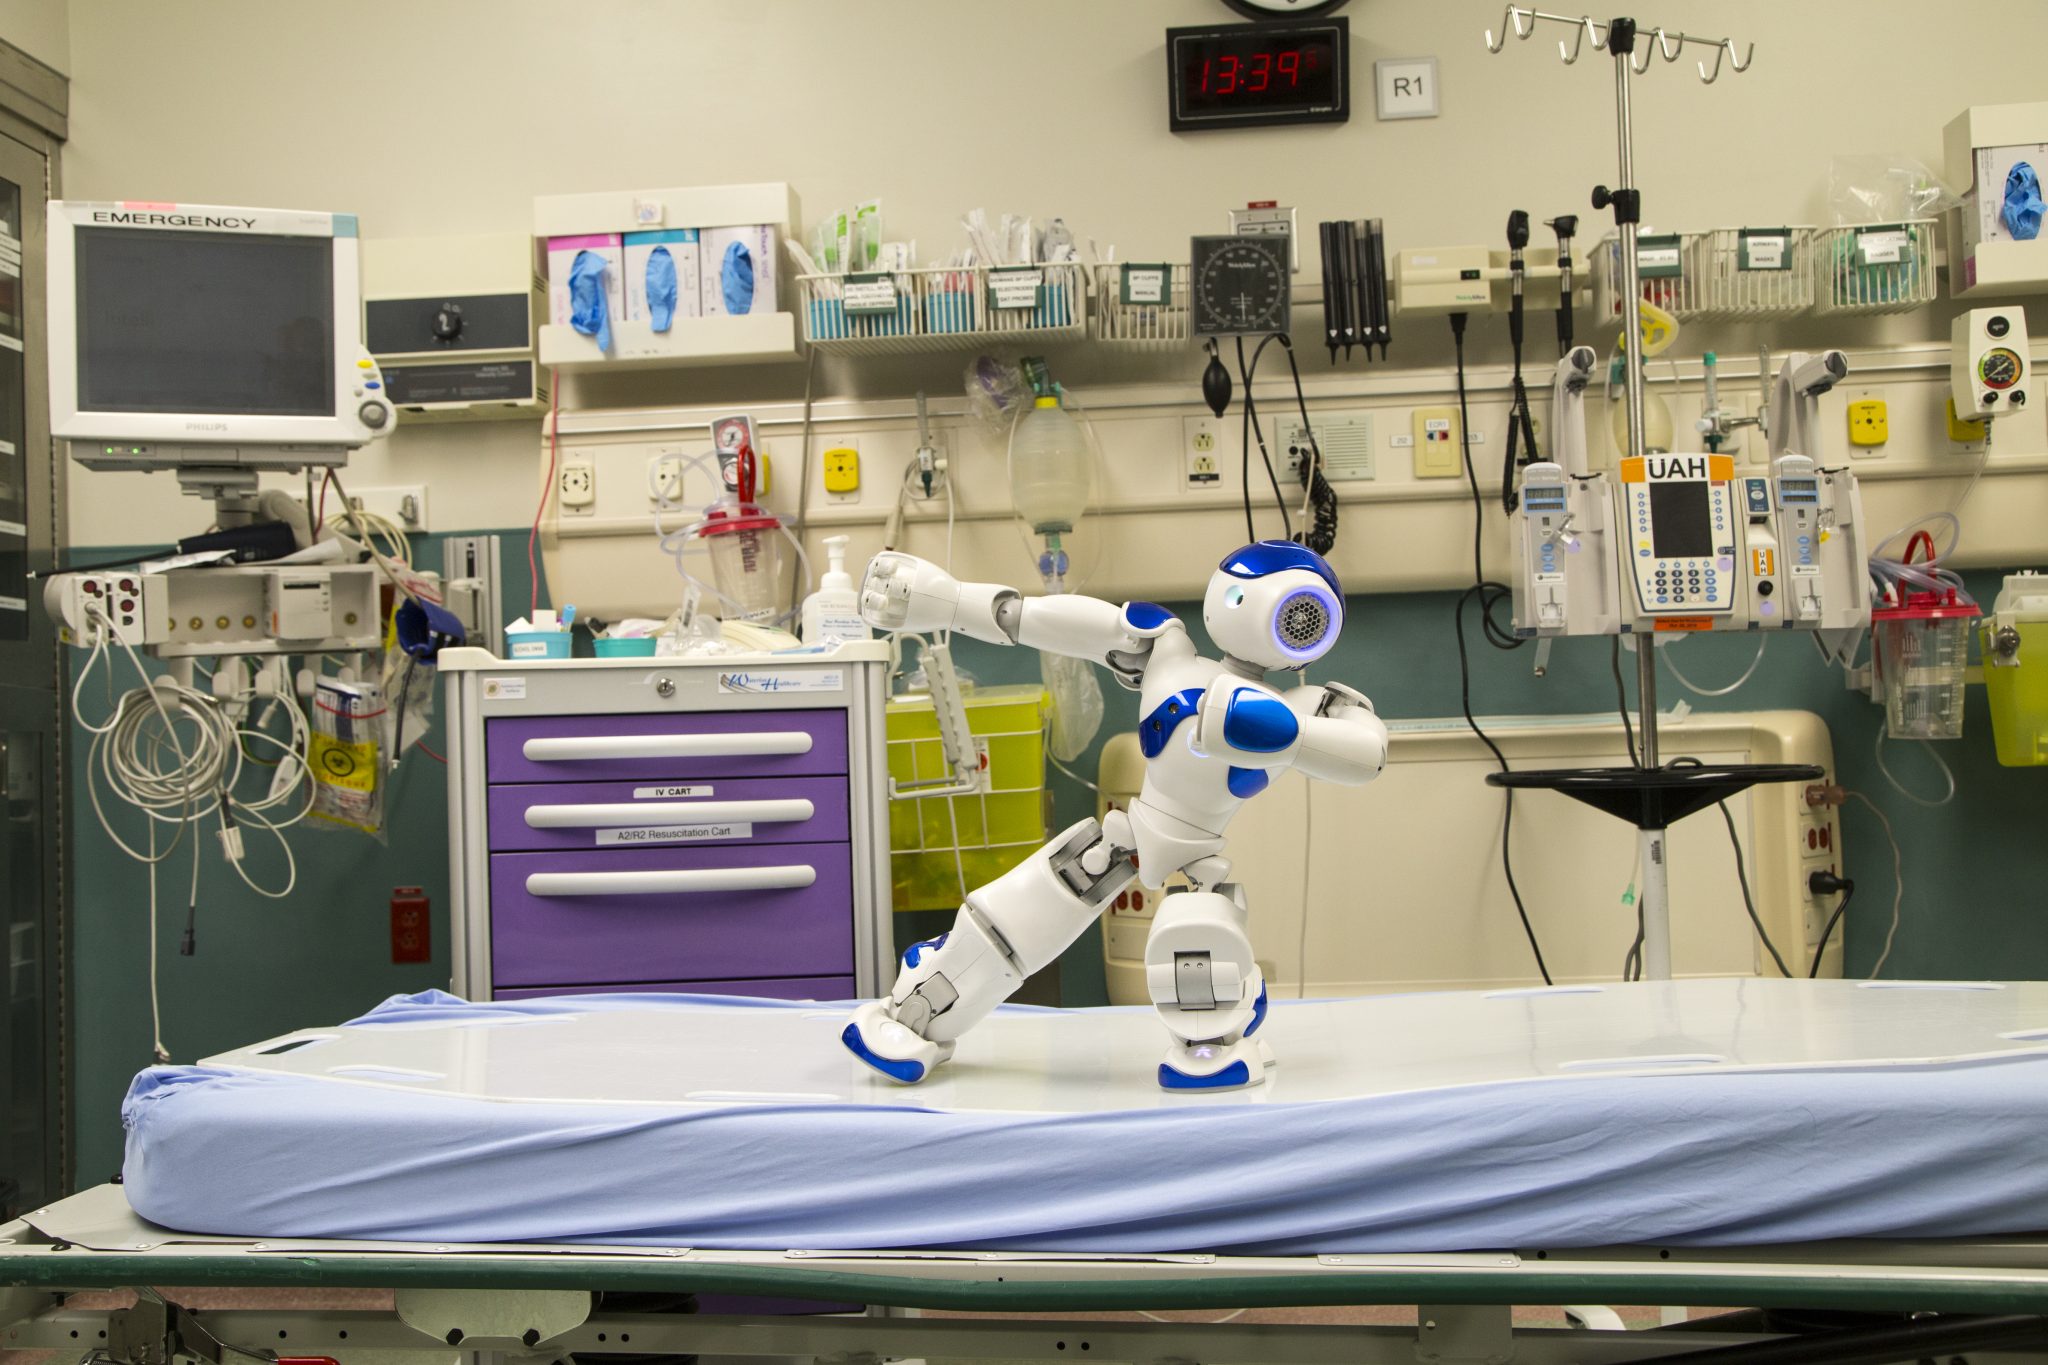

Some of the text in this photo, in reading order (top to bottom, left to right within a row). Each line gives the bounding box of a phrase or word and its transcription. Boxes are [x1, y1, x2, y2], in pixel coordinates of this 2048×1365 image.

[1201, 51, 1300, 95] 13:39
[1394, 76, 1423, 97] R1
[93, 211, 257, 229] EMERGENCY
[185, 422, 228, 431] PHILIPS
[1648, 457, 1707, 480] UAH
[1759, 551, 1767, 574] UAH
[655, 788, 692, 796] IV CART
[618, 827, 731, 841] A2/R2 Resuscitation Cart
